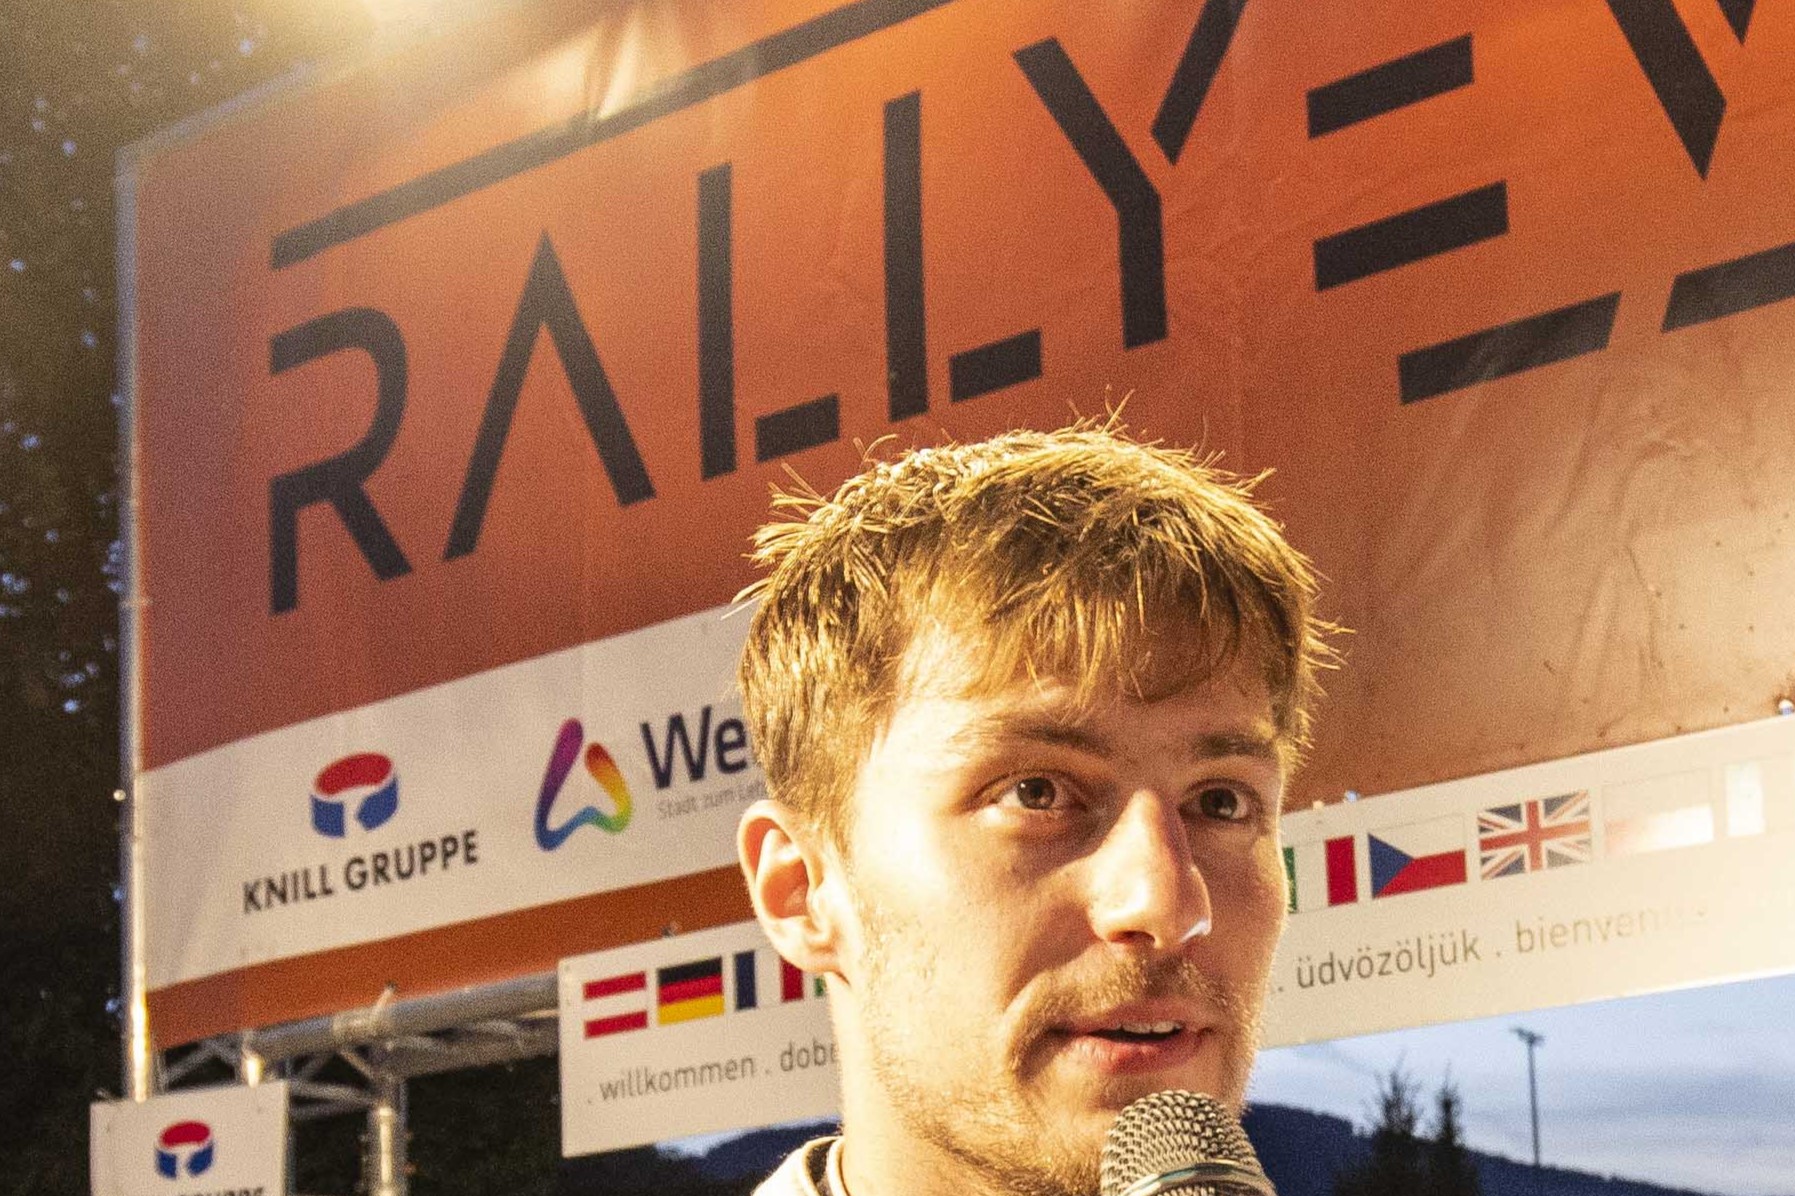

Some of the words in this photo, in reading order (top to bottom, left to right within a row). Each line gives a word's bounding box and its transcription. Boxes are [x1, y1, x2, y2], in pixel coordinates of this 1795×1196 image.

[639, 703, 749, 790] We
[242, 864, 334, 914] KNILL
[343, 829, 479, 891] GRUPPE
[600, 1055, 755, 1101] willkommen
[1295, 929, 1482, 989] üdvözöljük
